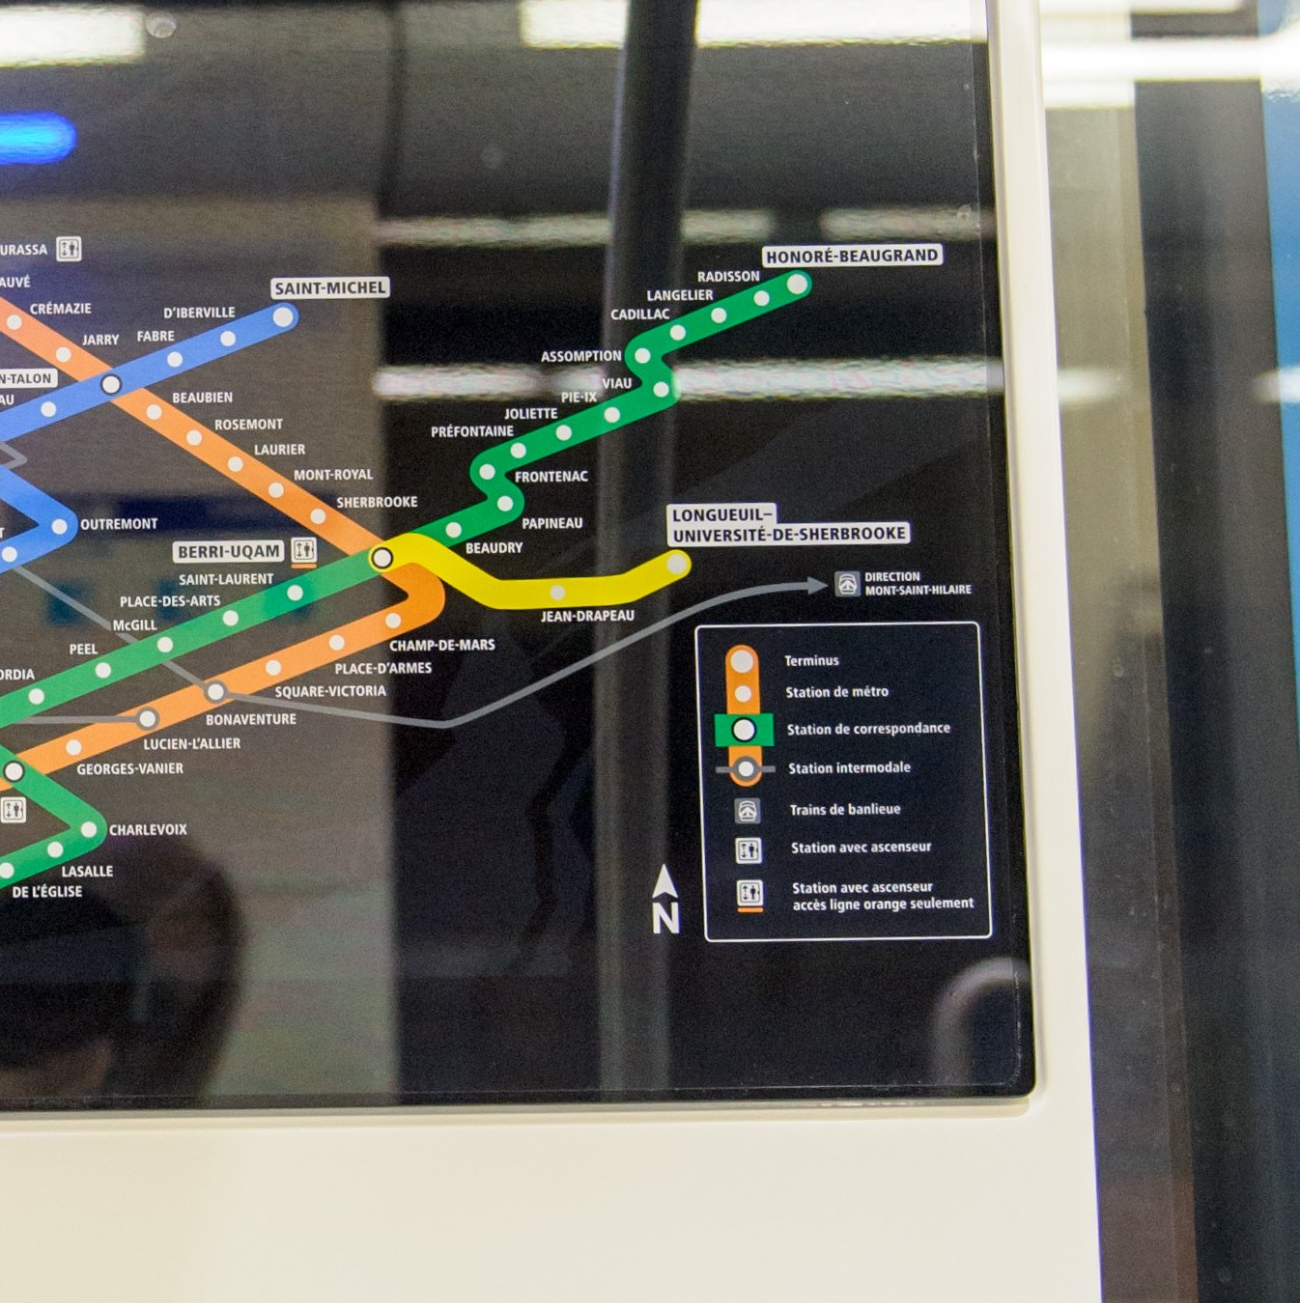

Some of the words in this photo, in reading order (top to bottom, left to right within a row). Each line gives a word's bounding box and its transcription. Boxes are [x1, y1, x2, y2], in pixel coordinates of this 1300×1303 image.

[766, 247, 938, 264] HONORÉ-BEAUGRAND
[698, 271, 760, 283] RADISSON
[275, 280, 386, 296] SAINT-MICHEL
[647, 290, 713, 301] LANGELIER
[30, 302, 91, 315] CRÉMAZIE
[164, 307, 235, 319] D'IBERVILLE
[611, 309, 669, 321] CADILLAC
[83, 334, 119, 346] JARRY
[137, 330, 175, 342] FABRE
[541, 351, 622, 363] ASSOMPTION
[603, 378, 632, 389] VIAU
[172, 391, 232, 403] BEAUBIEN
[562, 392, 597, 403] PIE-IX
[505, 408, 558, 420] JOLIETTE
[215, 418, 283, 431] ROSEMONT
[431, 424, 514, 437] PRÉFONTAINE
[254, 443, 305, 456] LAURIER
[294, 468, 373, 480] MONT-ROYAL
[516, 471, 588, 483] FRONTENAC
[337, 496, 417, 508] SHERBROOKE
[81, 518, 158, 530] OUTREMONT
[522, 518, 583, 529] PAPINEAU
[674, 525, 906, 543] UNIVERSITÉ-DE-SHERBROOKE
[178, 543, 280, 561] BERRI-UQAM
[466, 543, 523, 554] BEAUDRY
[179, 573, 273, 585] SAINT-LAURENT
[865, 572, 920, 581] DIRECTION
[866, 585, 972, 595] MONT-SAINT-HILAIRE
[120, 595, 220, 608] PLACE-DES-ARTS
[541, 610, 634, 622] JEAN-DRAPEAU
[113, 619, 156, 631] McGILL
[70, 643, 97, 655] PEEL
[390, 639, 495, 652] CHAMP-DE-MARS
[785, 655, 839, 666] Terminus
[335, 662, 432, 675] PLACE-D'ARMES
[275, 685, 386, 699] SQUARE-VICTORIA
[786, 686, 829, 698] Station
[832, 686, 849, 698] de
[852, 685, 889, 697] métro
[206, 714, 296, 726] BONAVENTURE
[787, 723, 832, 735] Station
[835, 723, 850, 735] de
[853, 722, 951, 736] correspondance
[144, 738, 241, 751] LUCIEN-L'ALLIER
[77, 763, 183, 775] GEORGES-VANIER
[788, 762, 833, 774] Station
[836, 761, 911, 773] intermodale
[790, 804, 827, 815] Trains
[831, 804, 845, 815] de
[849, 803, 901, 814] banlieue
[110, 824, 187, 836] CHARLEVOIX
[791, 842, 836, 853] Station
[840, 843, 868, 853] avec
[871, 841, 932, 852] ascenseur
[62, 866, 113, 878] LASALLE
[13, 886, 28, 898] DE
[792, 882, 837, 893] Station
[841, 883, 869, 893] avec
[872, 881, 933, 892] ascenseur
[829, 898, 860, 912] ligne
[863, 899, 907, 912] orange
[910, 897, 974, 909] seulement
[652, 903, 679, 934] N
